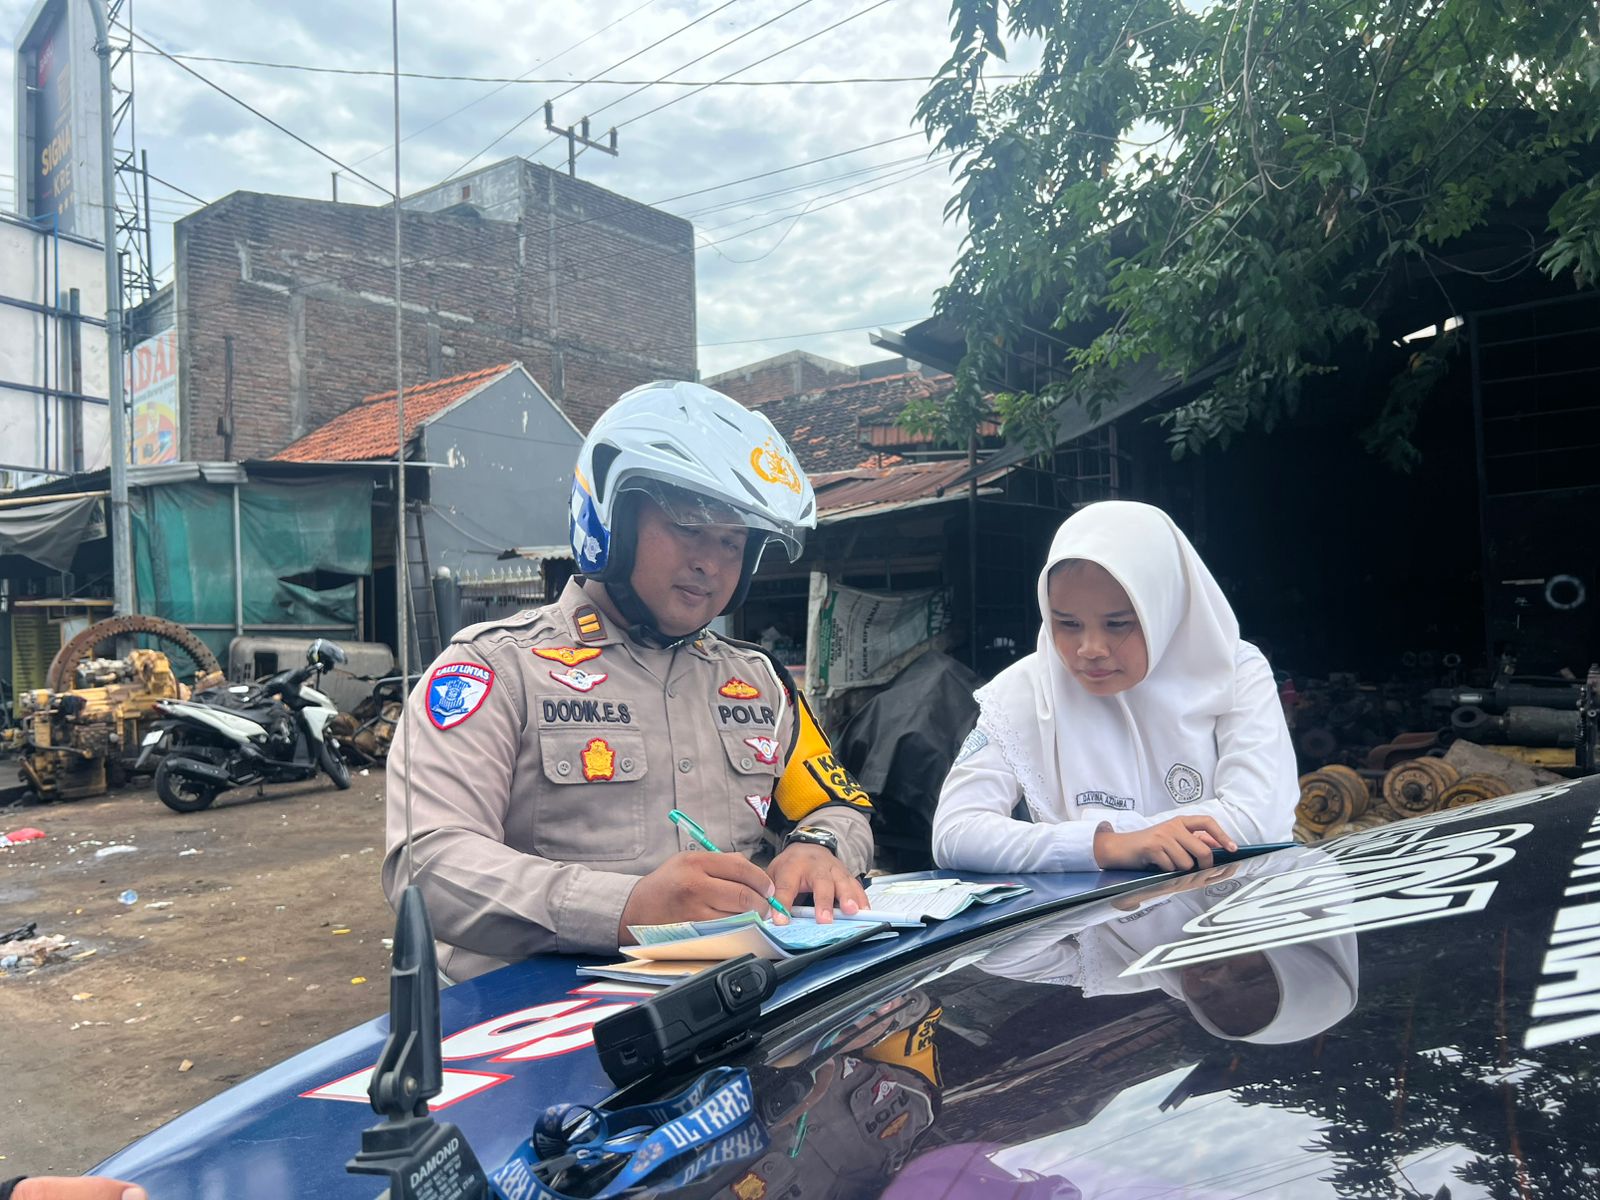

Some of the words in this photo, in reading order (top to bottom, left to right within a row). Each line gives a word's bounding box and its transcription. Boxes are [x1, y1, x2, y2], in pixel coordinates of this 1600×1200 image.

[53, 159, 74, 198] KRE
[436, 665, 458, 676] LALU
[458, 665, 490, 680] LINTAS
[542, 699, 632, 723] DODIK.E.S
[661, 1079, 751, 1149] ULTRAS
